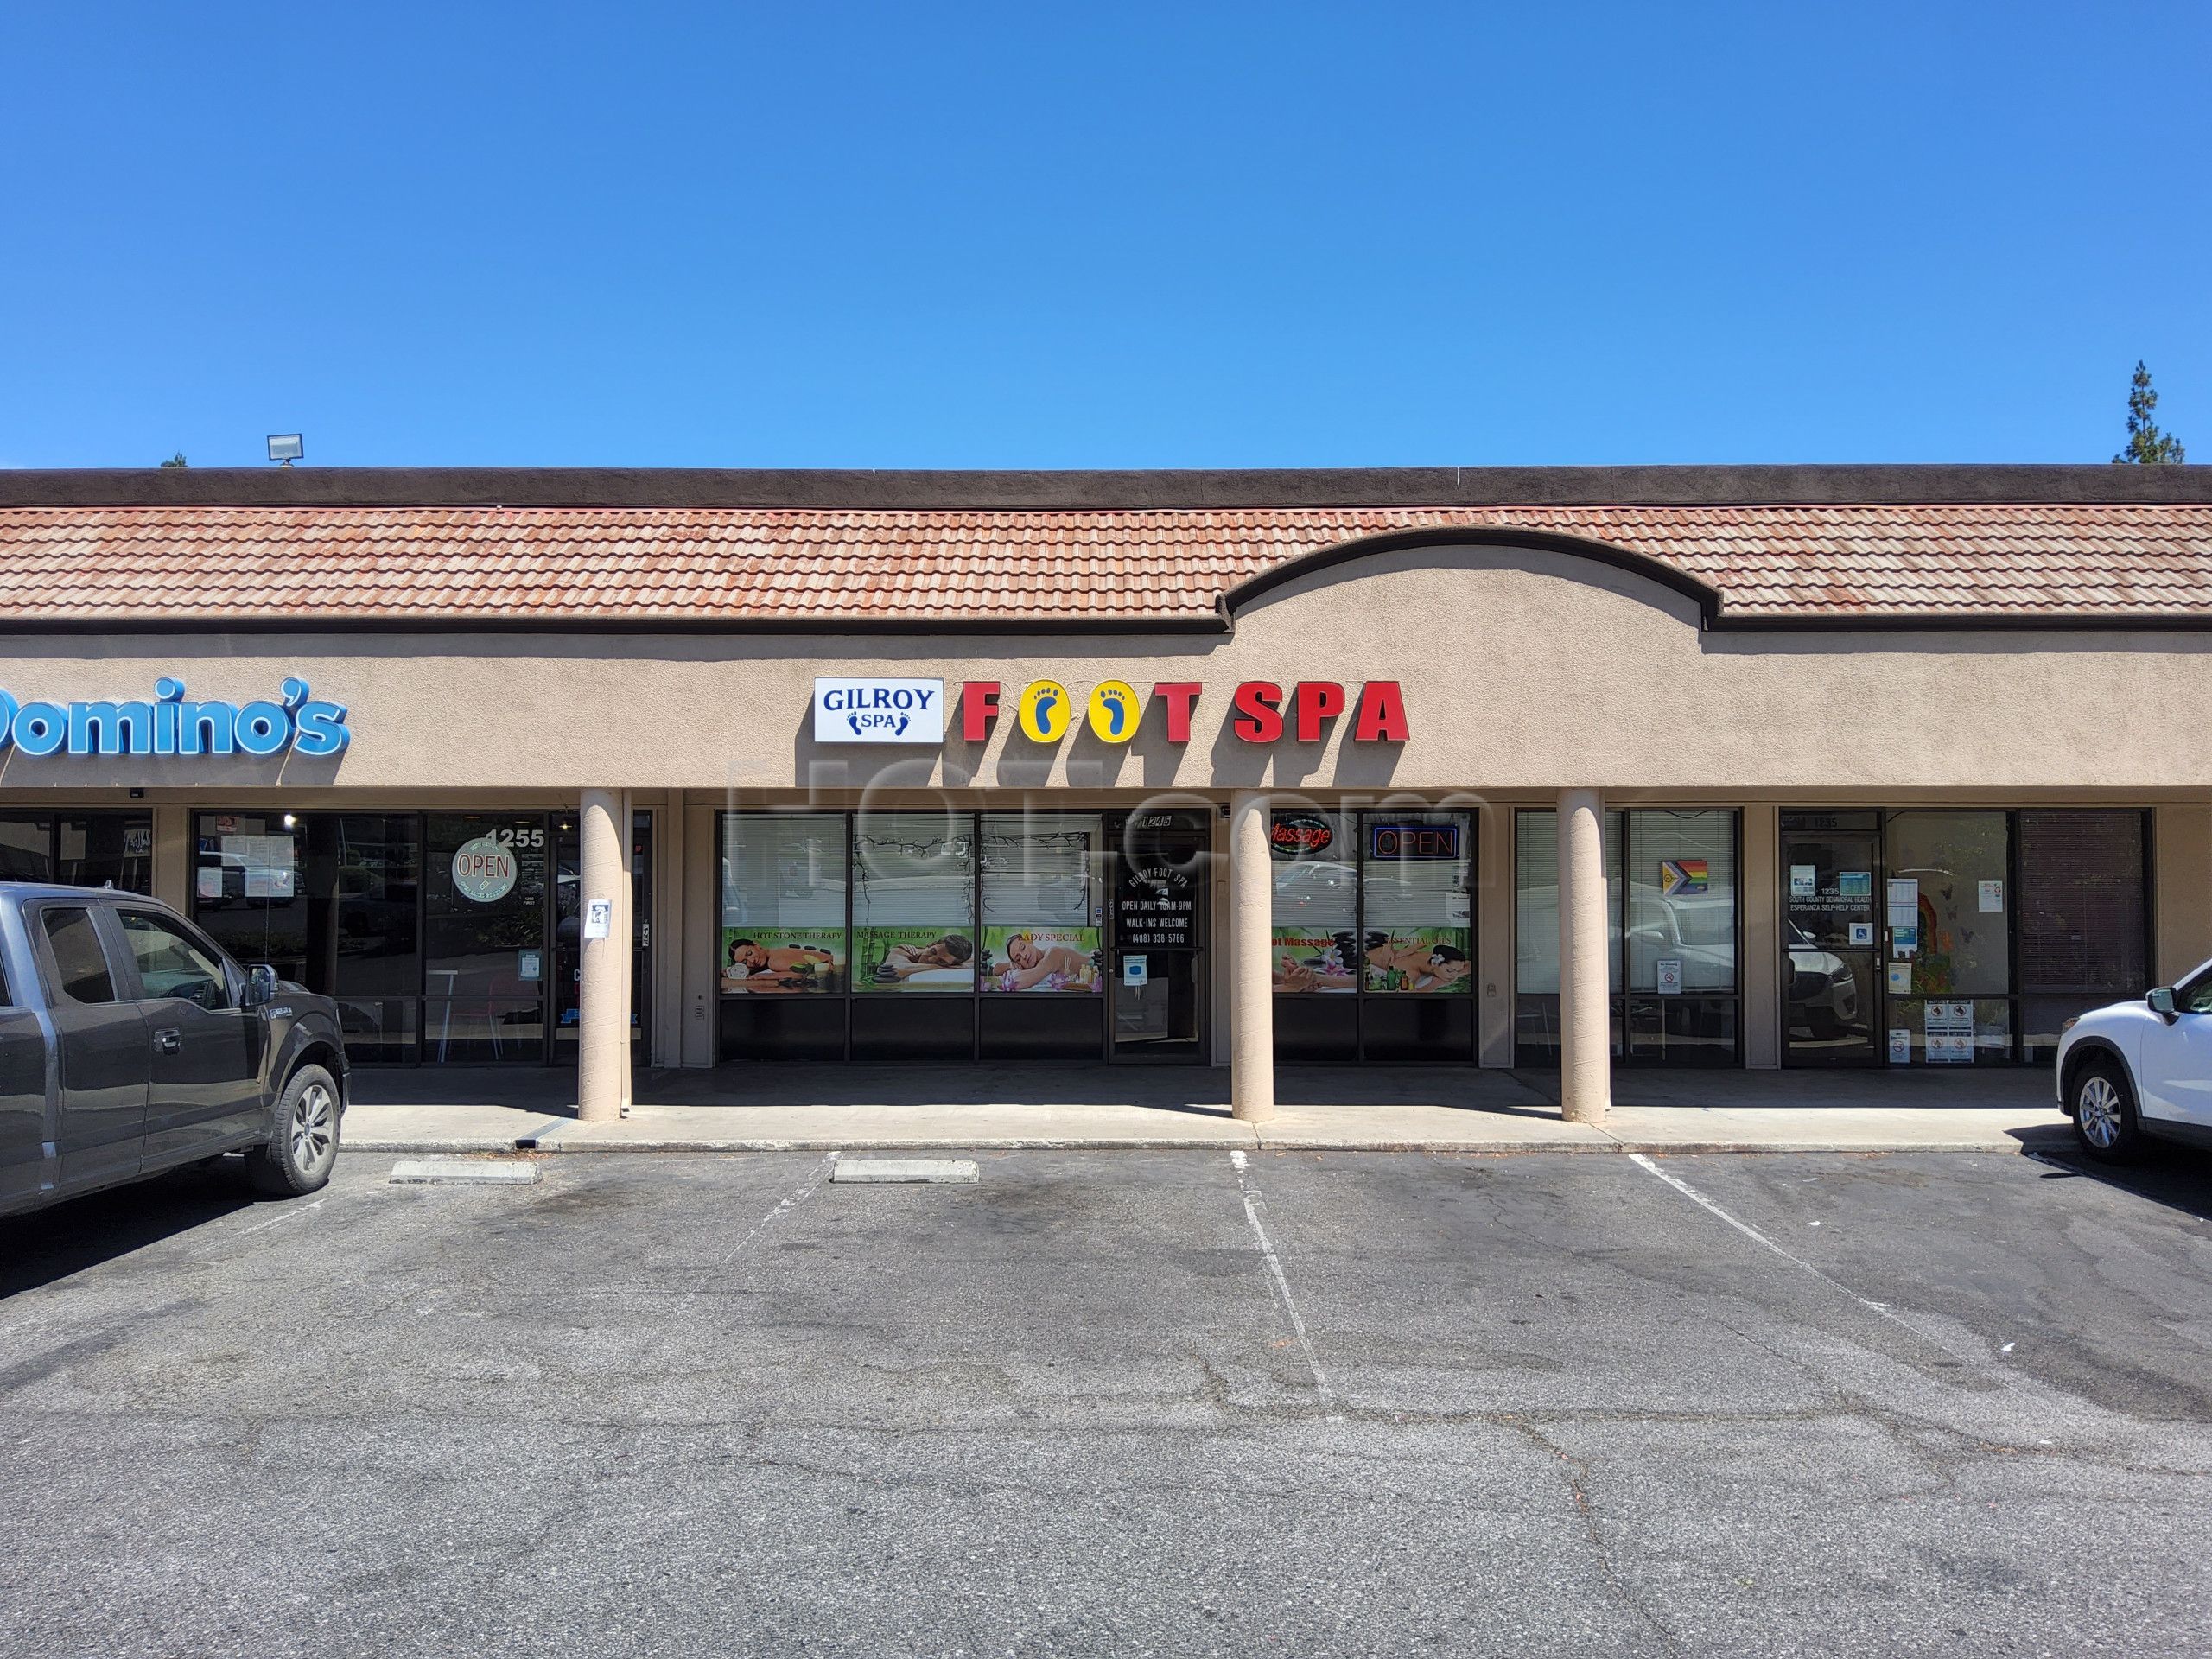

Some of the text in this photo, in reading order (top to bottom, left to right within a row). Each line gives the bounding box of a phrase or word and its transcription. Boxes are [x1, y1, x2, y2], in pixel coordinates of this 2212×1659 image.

[823, 688, 935, 711] GILROY
[0, 677, 349, 755] omino's
[962, 680, 1410, 743] FOOT SPA
[861, 714, 896, 728] SPA
[1141, 816, 1172, 827] 1245
[486, 830, 544, 847] 1255
[1378, 831, 1452, 855] OPEN
[458, 854, 509, 878] OPEN
[1128, 868, 1188, 888] GILROY FOOT SPA
[1122, 900, 1138, 910] OPEN
[1140, 900, 1156, 910] DAILY
[1126, 918, 1188, 927] WALK-INS WELCOME
[1132, 933, 1185, 943] (408) 338-5766
[1284, 937, 1335, 948] Massage
